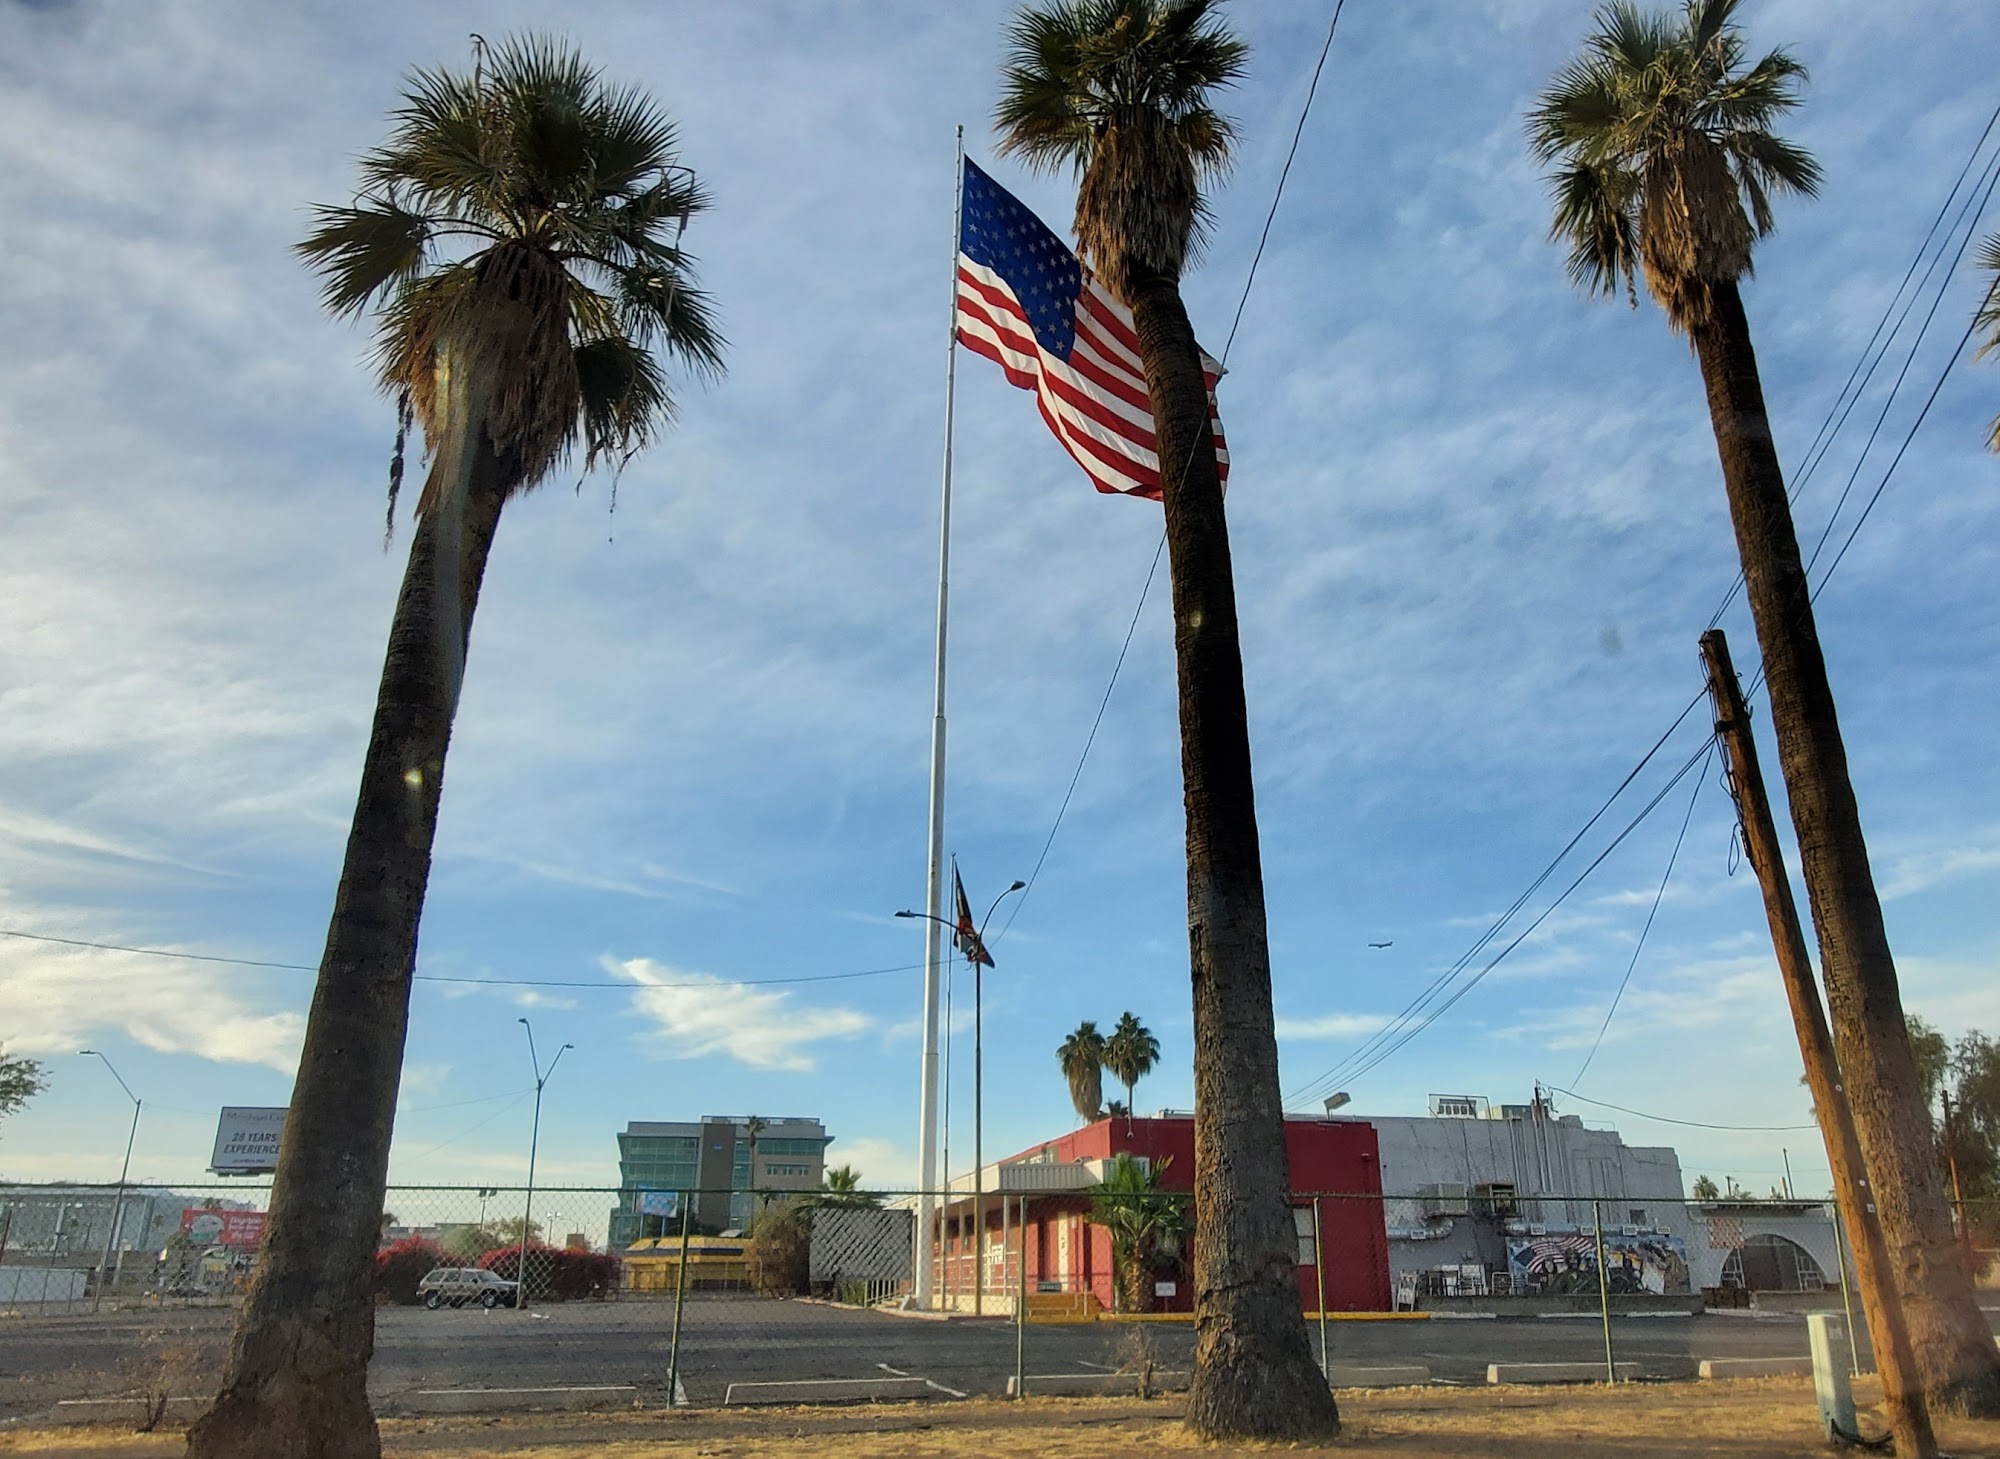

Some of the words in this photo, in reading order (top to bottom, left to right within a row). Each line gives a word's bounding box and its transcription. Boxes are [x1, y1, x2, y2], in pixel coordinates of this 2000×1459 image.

[232, 1132, 246, 1143] 28
[248, 1132, 278, 1143] YEARS
[223, 1144, 282, 1155] EXPERIENCE
